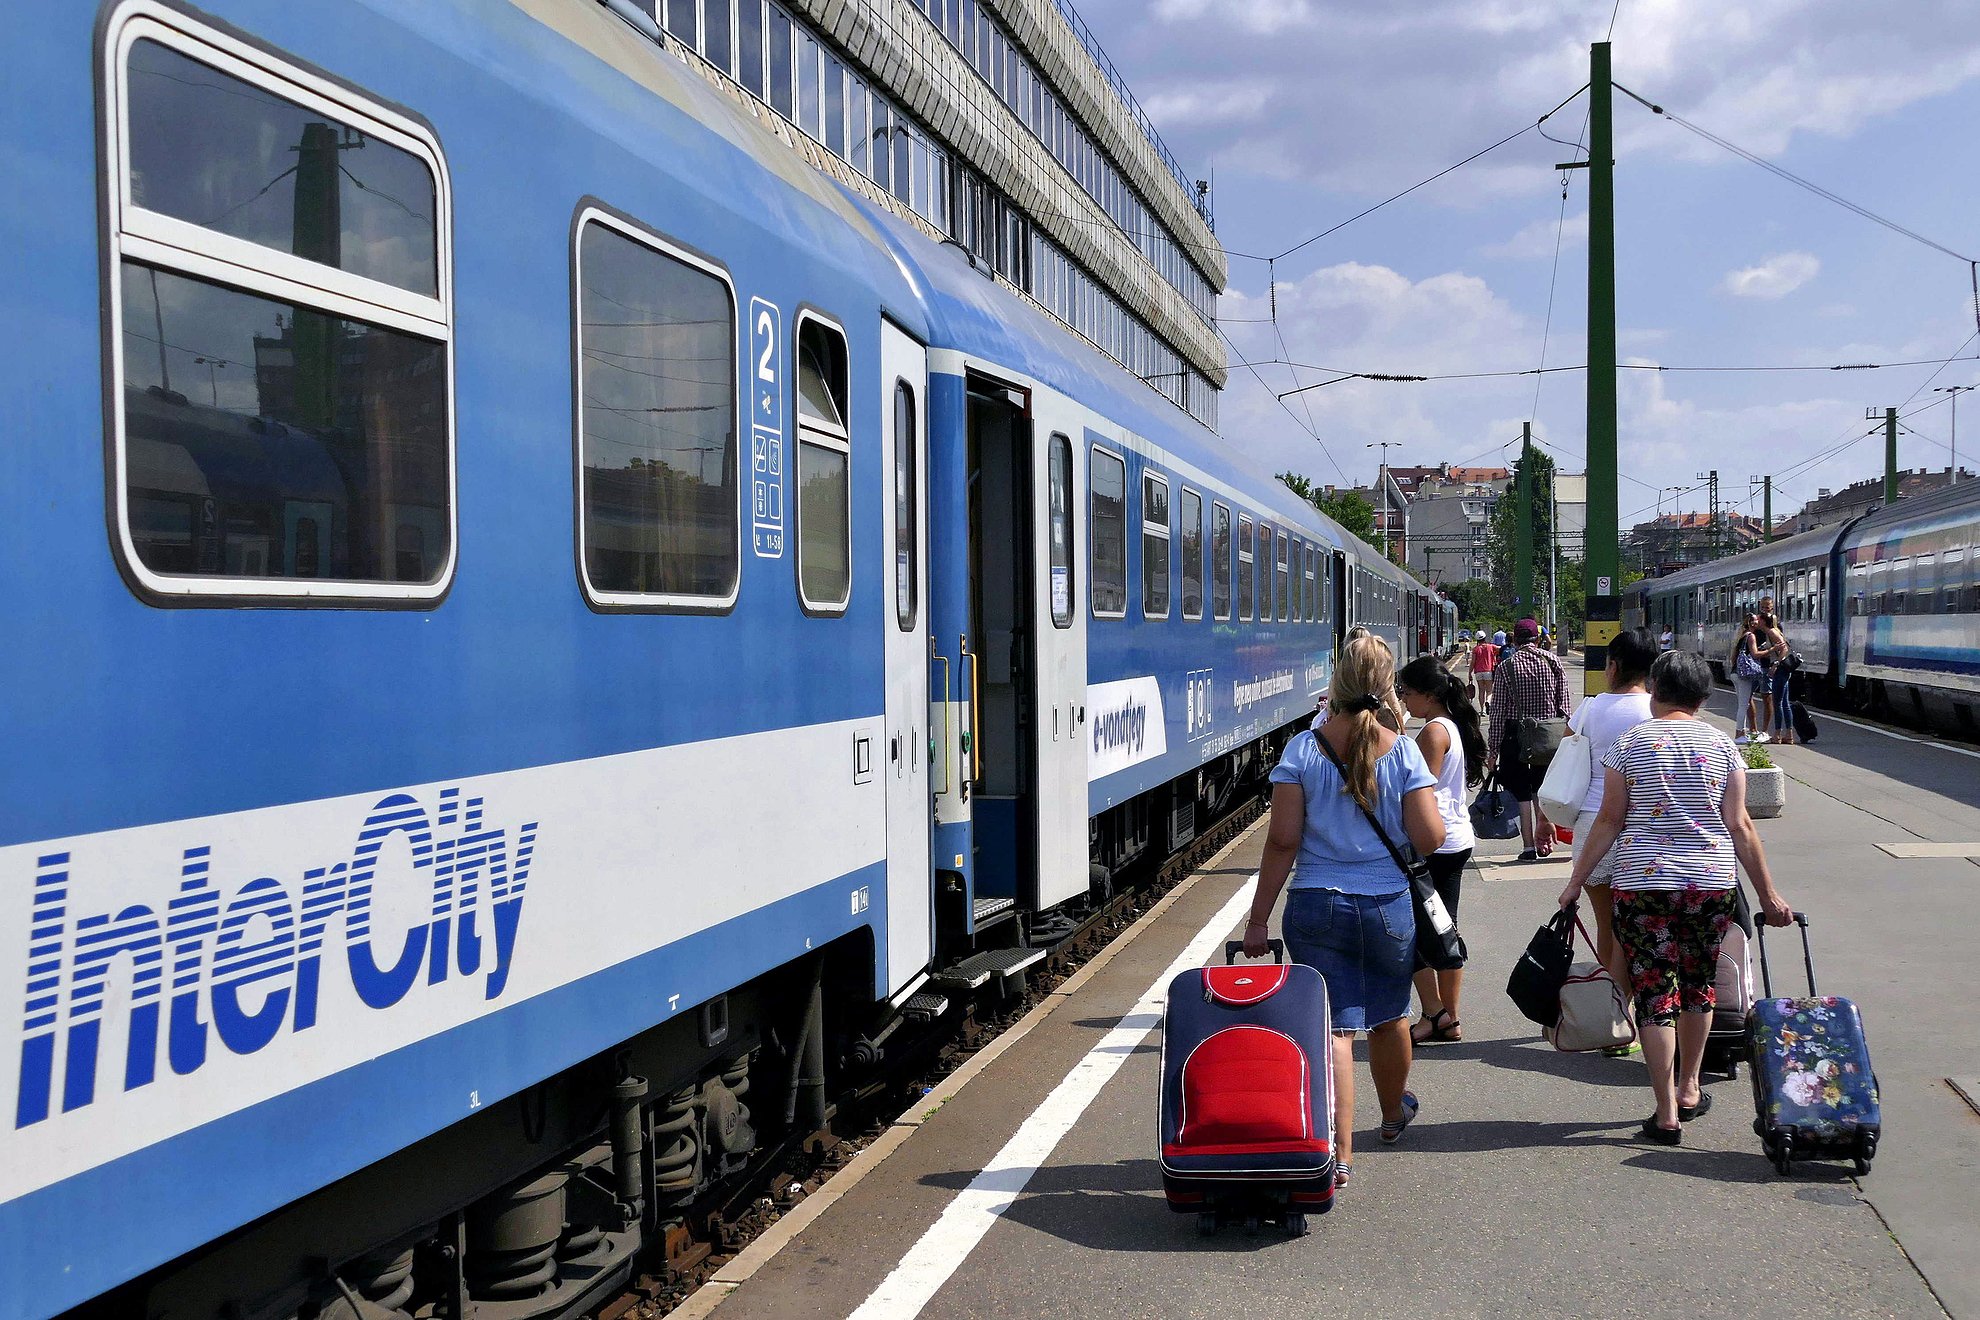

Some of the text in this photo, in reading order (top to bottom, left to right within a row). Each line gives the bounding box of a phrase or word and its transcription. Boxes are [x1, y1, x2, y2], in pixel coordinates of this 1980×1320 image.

[757, 310, 775, 383] 2
[1093, 694, 1146, 755] e-vonatjegy
[15, 787, 539, 1130] InterCity
[470, 1090, 481, 1109] 3L
